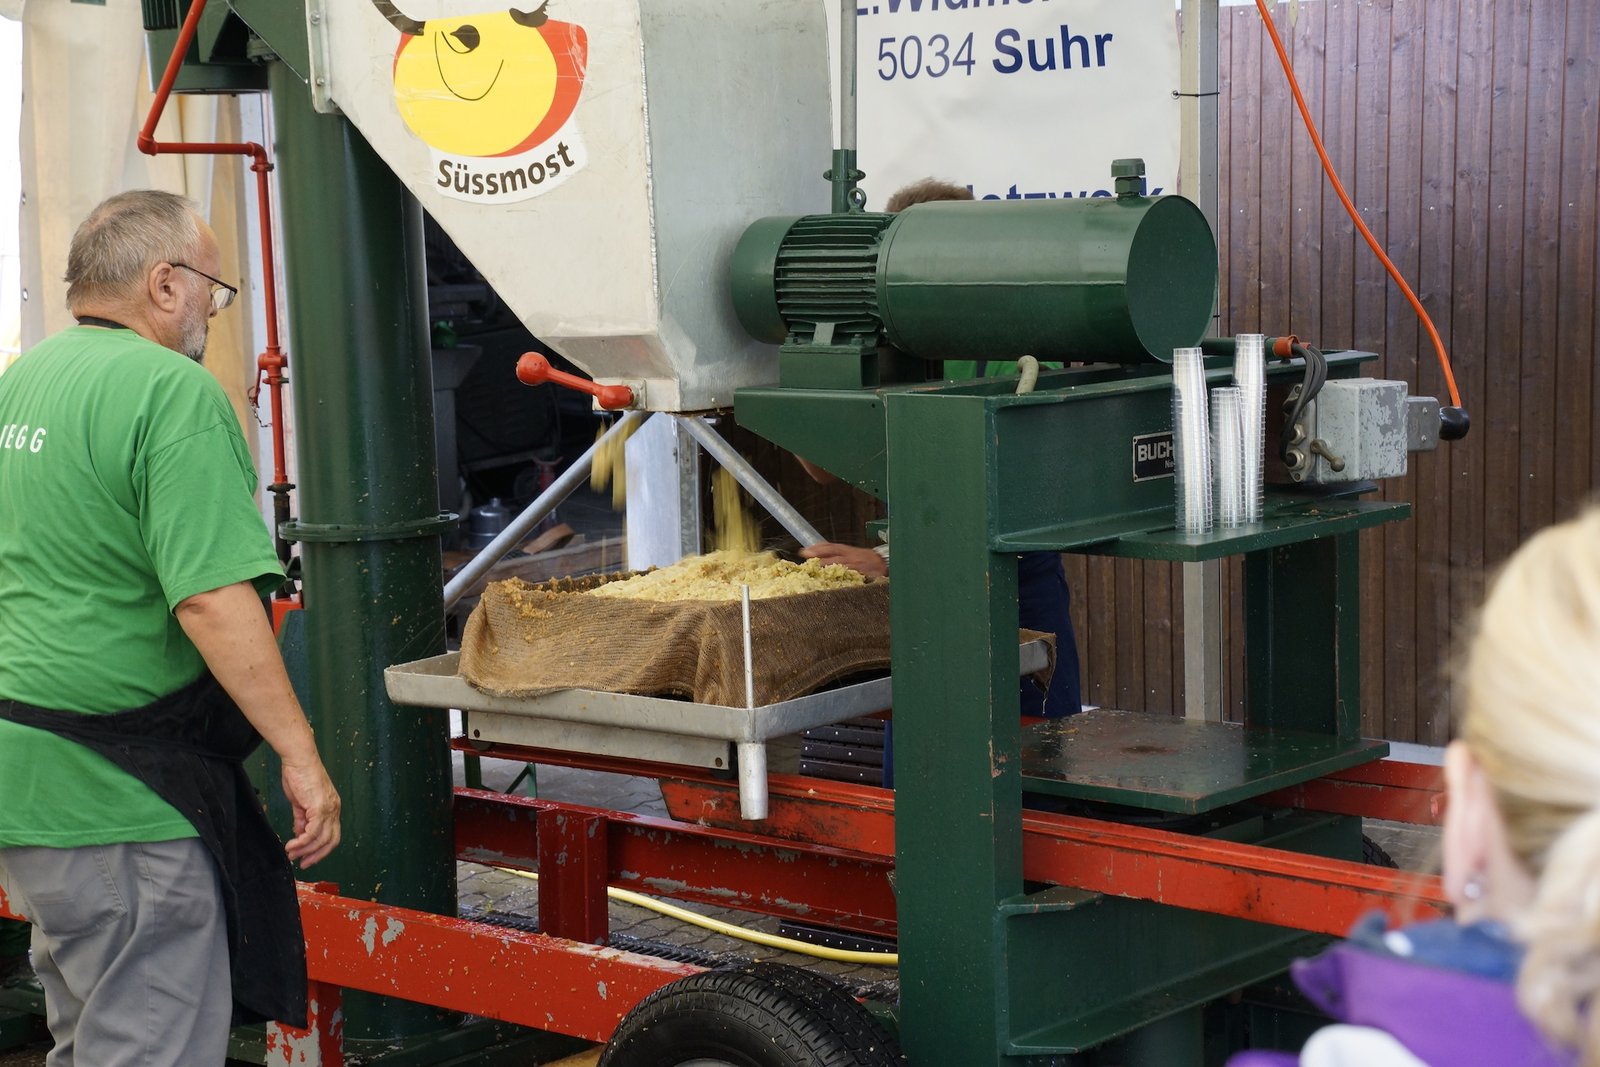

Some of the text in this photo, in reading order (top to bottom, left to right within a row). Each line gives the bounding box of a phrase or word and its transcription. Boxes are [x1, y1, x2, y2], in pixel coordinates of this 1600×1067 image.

[877, 24, 1113, 81] 5034 Suhr
[437, 141, 575, 195] Süssmost
